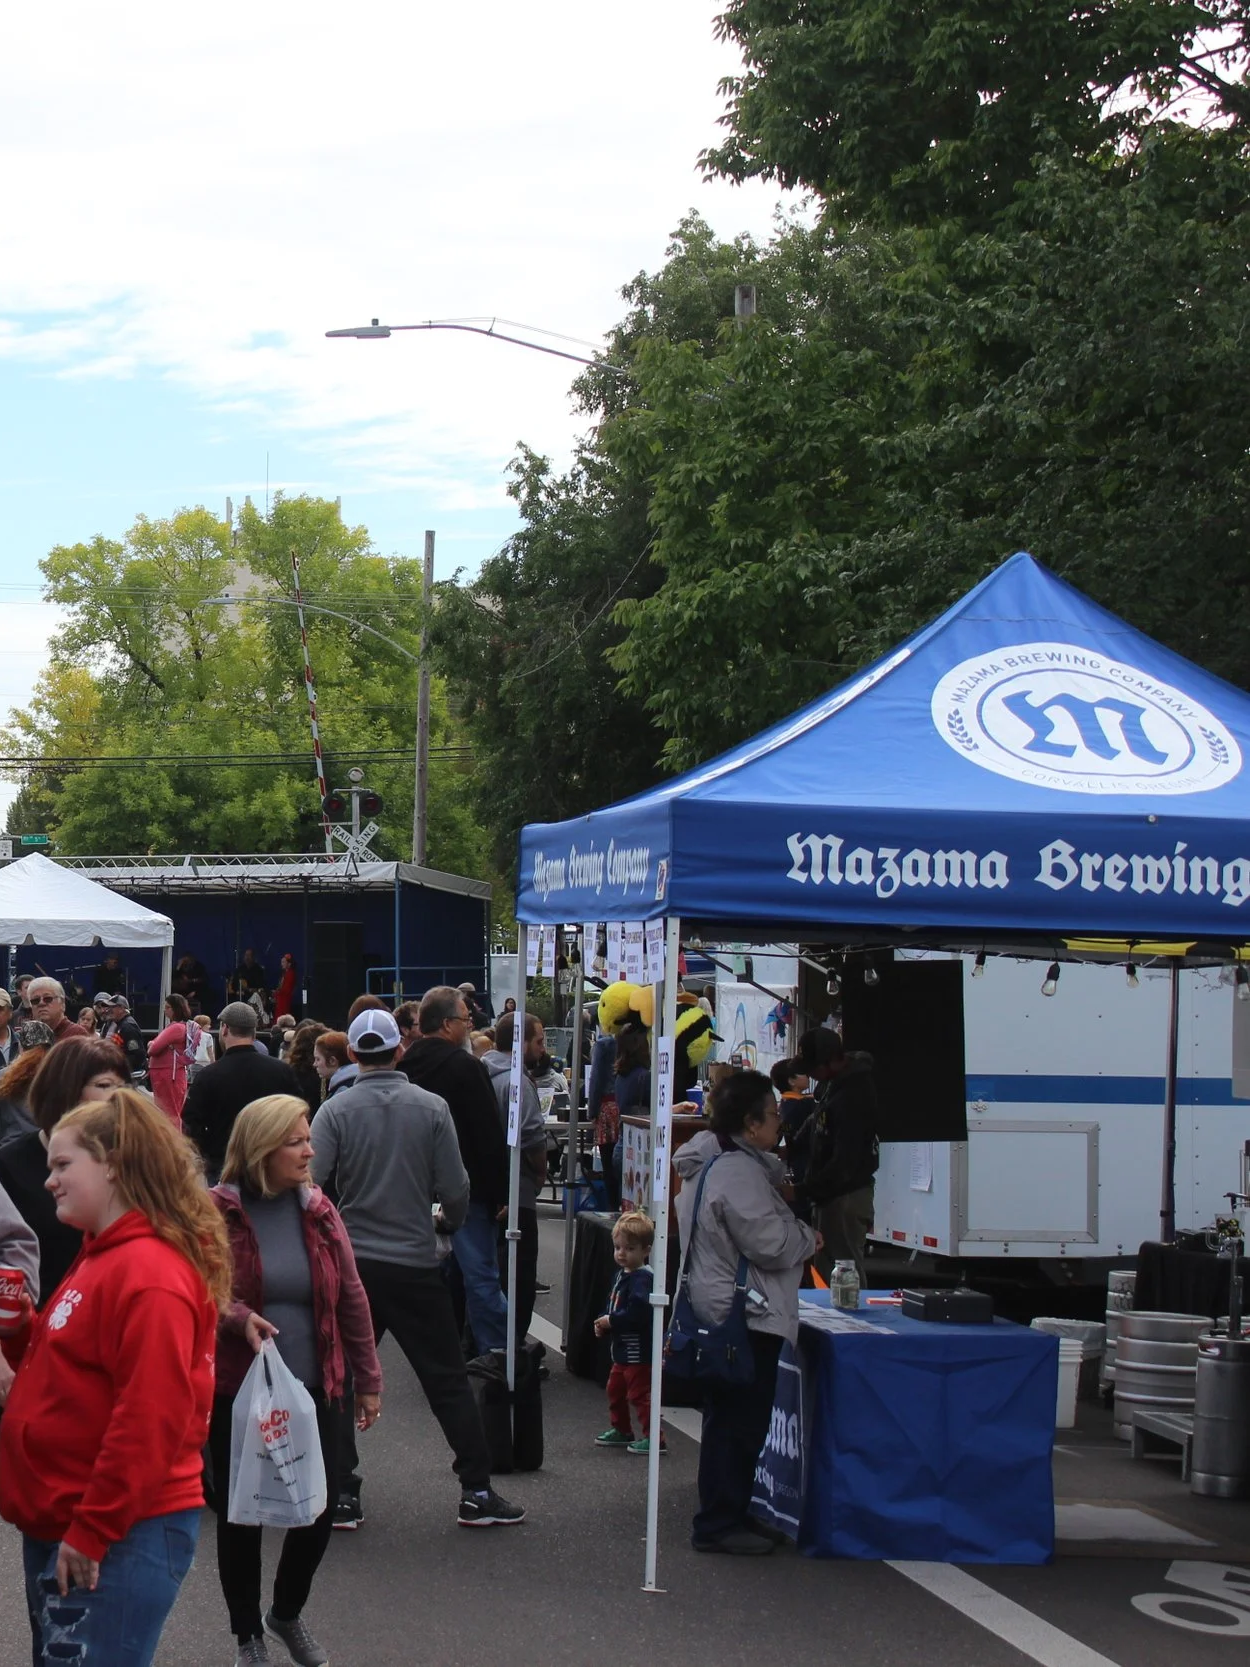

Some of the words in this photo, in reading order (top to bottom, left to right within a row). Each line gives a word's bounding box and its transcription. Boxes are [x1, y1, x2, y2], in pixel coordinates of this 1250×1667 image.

[951, 664, 1004, 704] MAZAMA
[1004, 651, 1101, 669] BREWING
[1109, 668, 1198, 719] COMPANY
[1021, 768, 1128, 790] CORVALLIS
[334, 827, 351, 844] RAIL
[786, 832, 1009, 898] Mazama
[1034, 839, 1250, 907] Brewing
